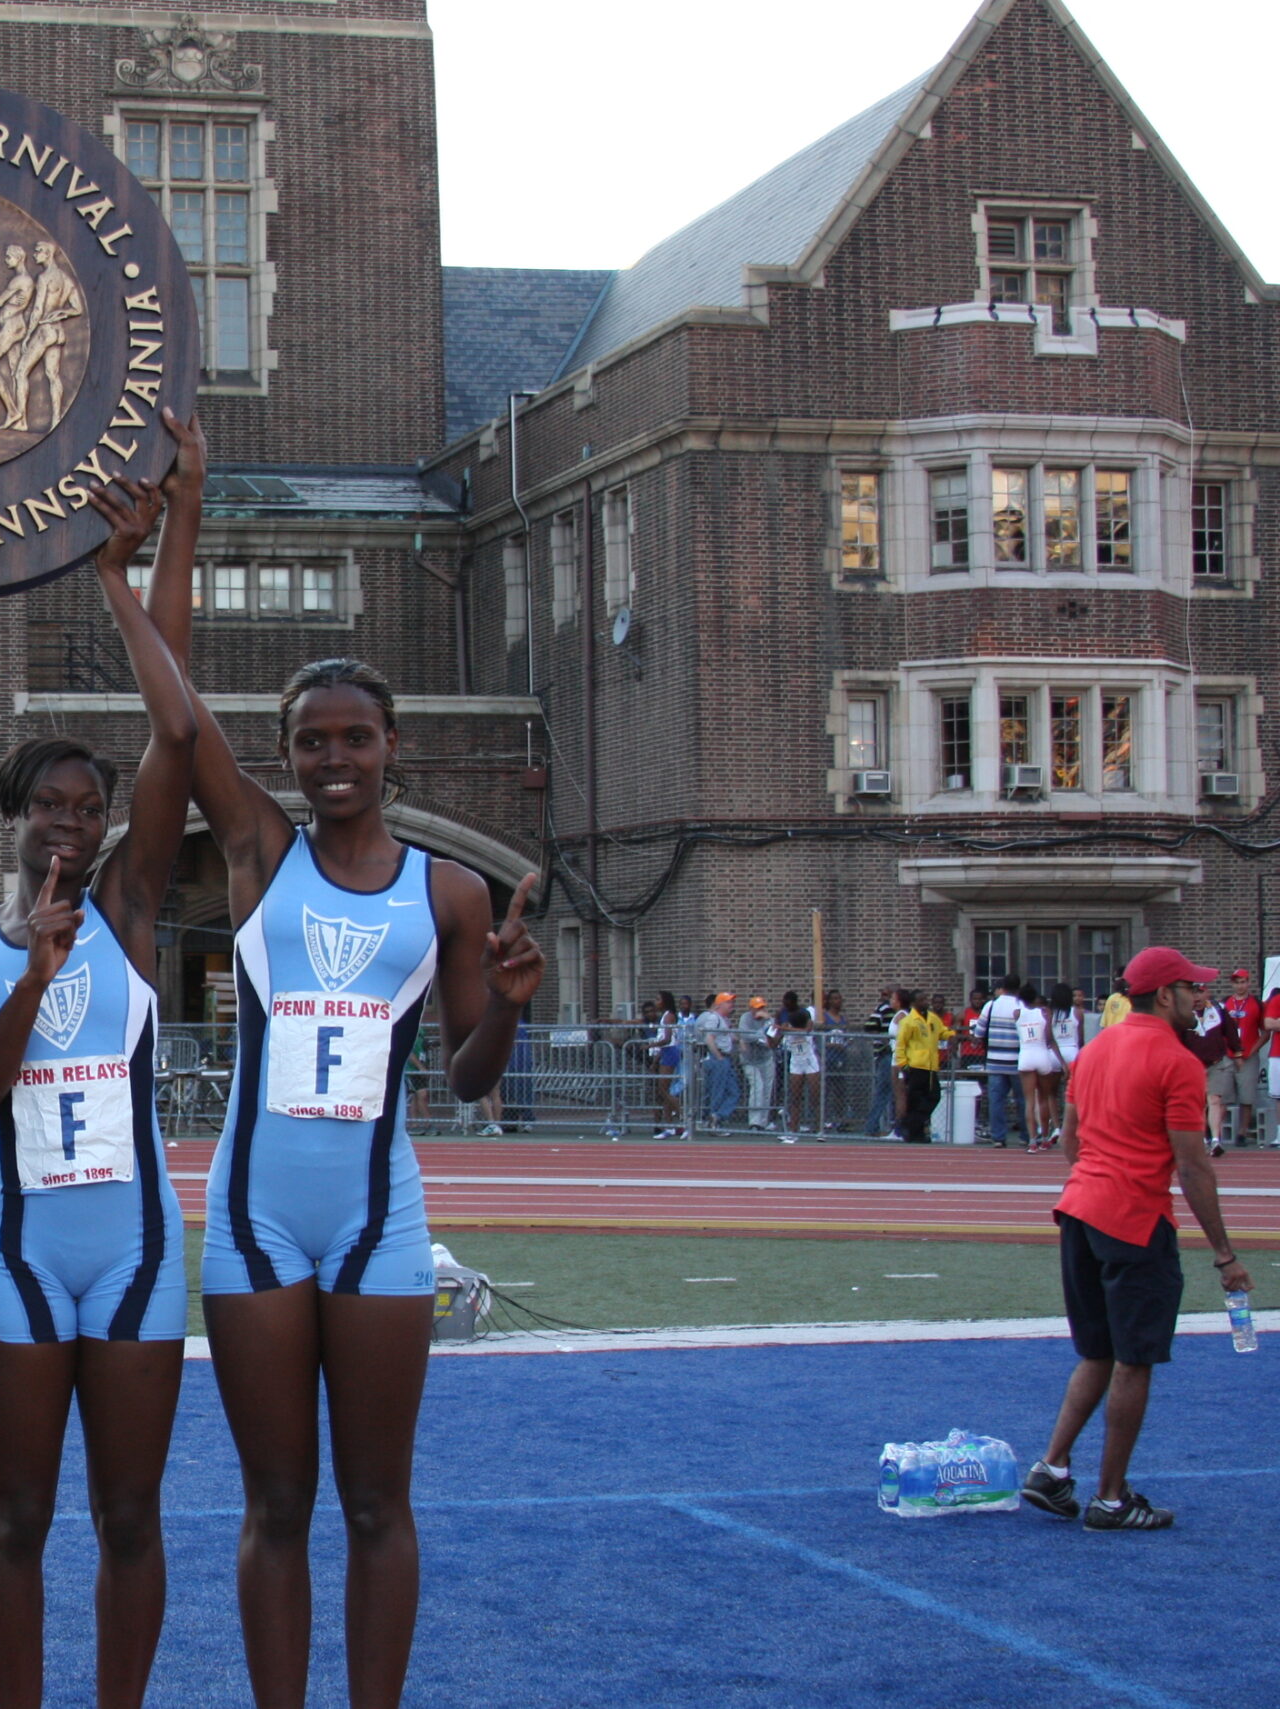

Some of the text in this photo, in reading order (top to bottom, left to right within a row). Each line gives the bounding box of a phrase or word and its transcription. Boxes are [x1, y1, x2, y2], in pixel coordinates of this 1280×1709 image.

[272, 1000, 390, 1020] PENN RELAYS
[315, 1026, 344, 1094] F
[63, 1063, 128, 1083] RELAYS
[288, 1104, 363, 1118] since 1895
[59, 1091, 86, 1160] F
[41, 1167, 113, 1186] since 1895
[938, 1460, 988, 1484] AQUAFINA
